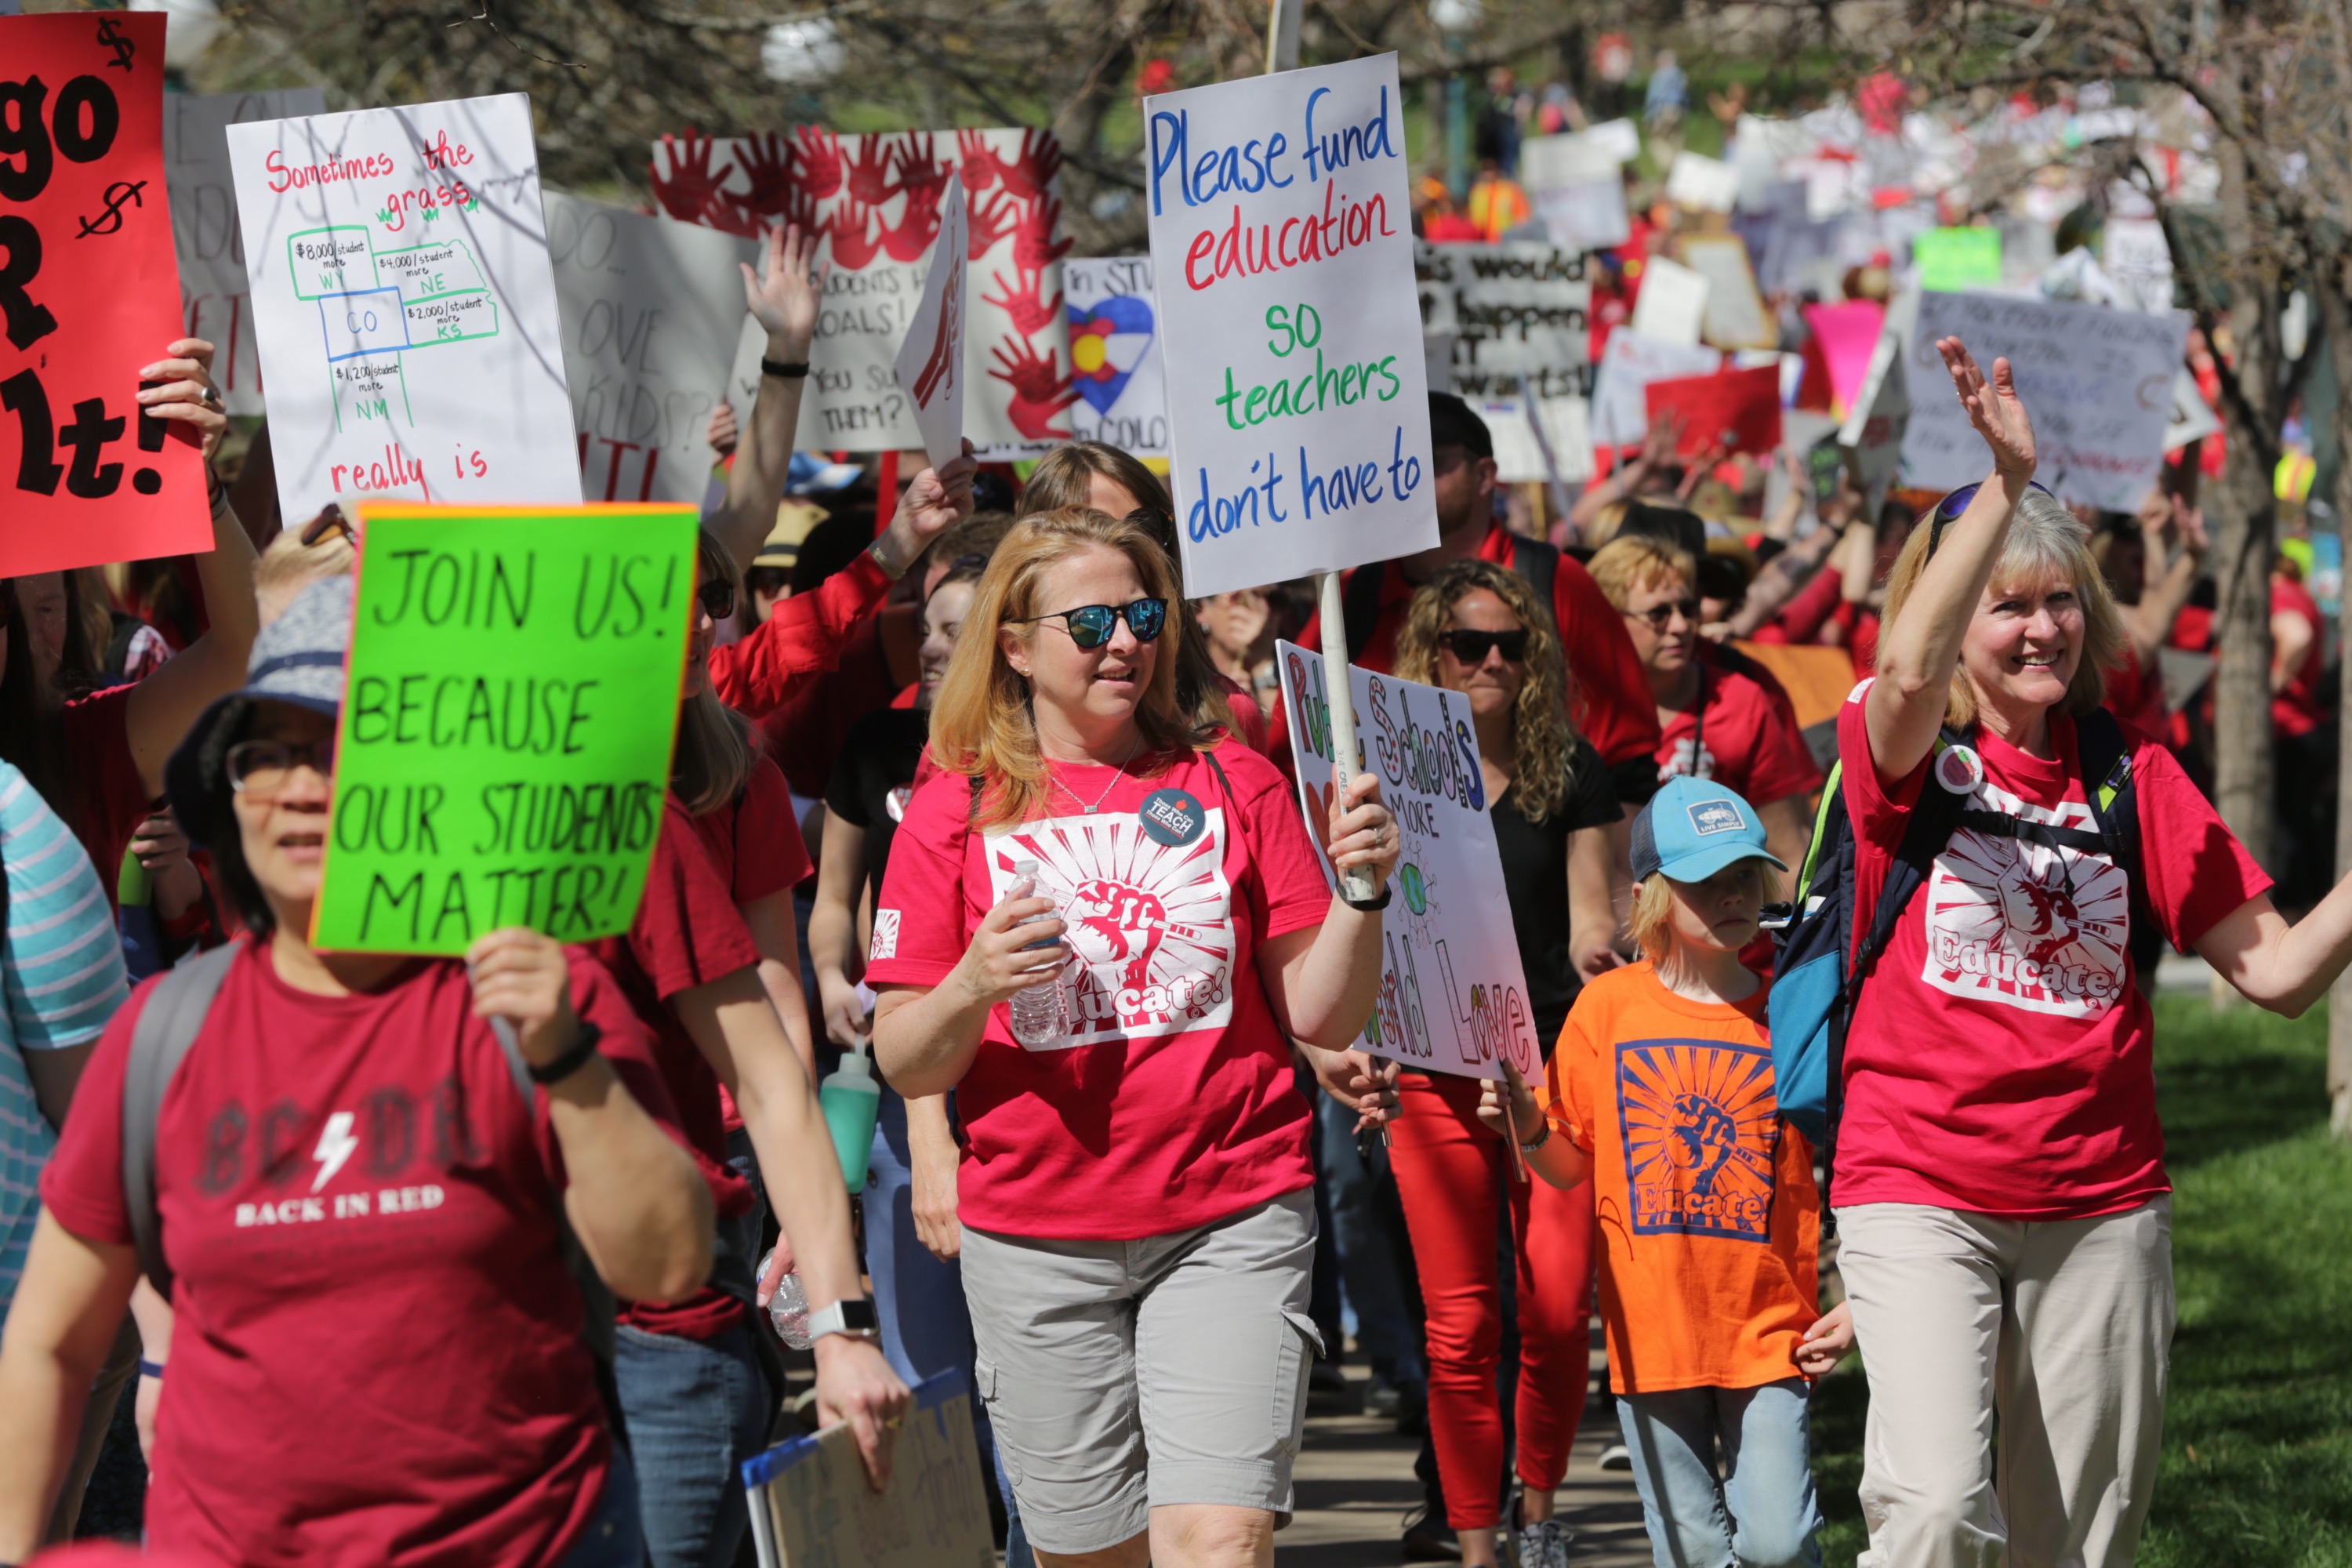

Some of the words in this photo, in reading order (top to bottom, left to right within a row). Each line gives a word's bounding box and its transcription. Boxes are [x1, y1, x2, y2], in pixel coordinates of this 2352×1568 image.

[266, 150, 394, 193] Sometimes
[422, 129, 474, 170] the
[1151, 108, 1294, 216] Please
[1302, 86, 1399, 182] fund
[385, 181, 470, 231] grass
[296, 241, 365, 262] $8,000/student
[1185, 177, 1396, 291] education
[318, 269, 344, 289] WY
[323, 258, 346, 269] more
[406, 267, 429, 278] more
[420, 273, 446, 294] NE
[347, 310, 377, 334] CO
[437, 314, 460, 325] more
[437, 323, 463, 339] KS
[577, 298, 663, 376] OVE
[812, 299, 906, 339] OALS!
[356, 397, 390, 420] NM
[358, 382, 383, 392] more
[1215, 347, 1400, 430] teachers
[822, 394, 904, 434] THEM?
[1098, 416, 1166, 450] COLO
[331, 442, 431, 504] really
[456, 443, 488, 480] is
[1189, 452, 1287, 543] don't
[1300, 445, 1383, 520] have
[1387, 426, 1421, 502] to
[373, 549, 535, 630] JOIN
[574, 554, 678, 641] US!
[351, 673, 599, 757] BECAUSE
[1369, 676, 1484, 812] Schools
[336, 782, 445, 856] OUR
[474, 781, 662, 856] STUDENTS
[1145, 809, 1161, 821] Those
[1160, 818, 1173, 828] Who
[1150, 800, 1192, 833] TEACH
[1156, 797, 1171, 809] Those
[1171, 806, 1183, 817] Who
[1389, 793, 1439, 838] MORE
[358, 864, 630, 942] MATTER!
[1934, 925, 2125, 1001] Educate!
[1065, 966, 1224, 1025] ucate!
[1435, 939, 1530, 1074] Love
[234, 1196, 326, 1227] BACK
[333, 1192, 370, 1219] IN
[379, 1184, 445, 1214] RED
